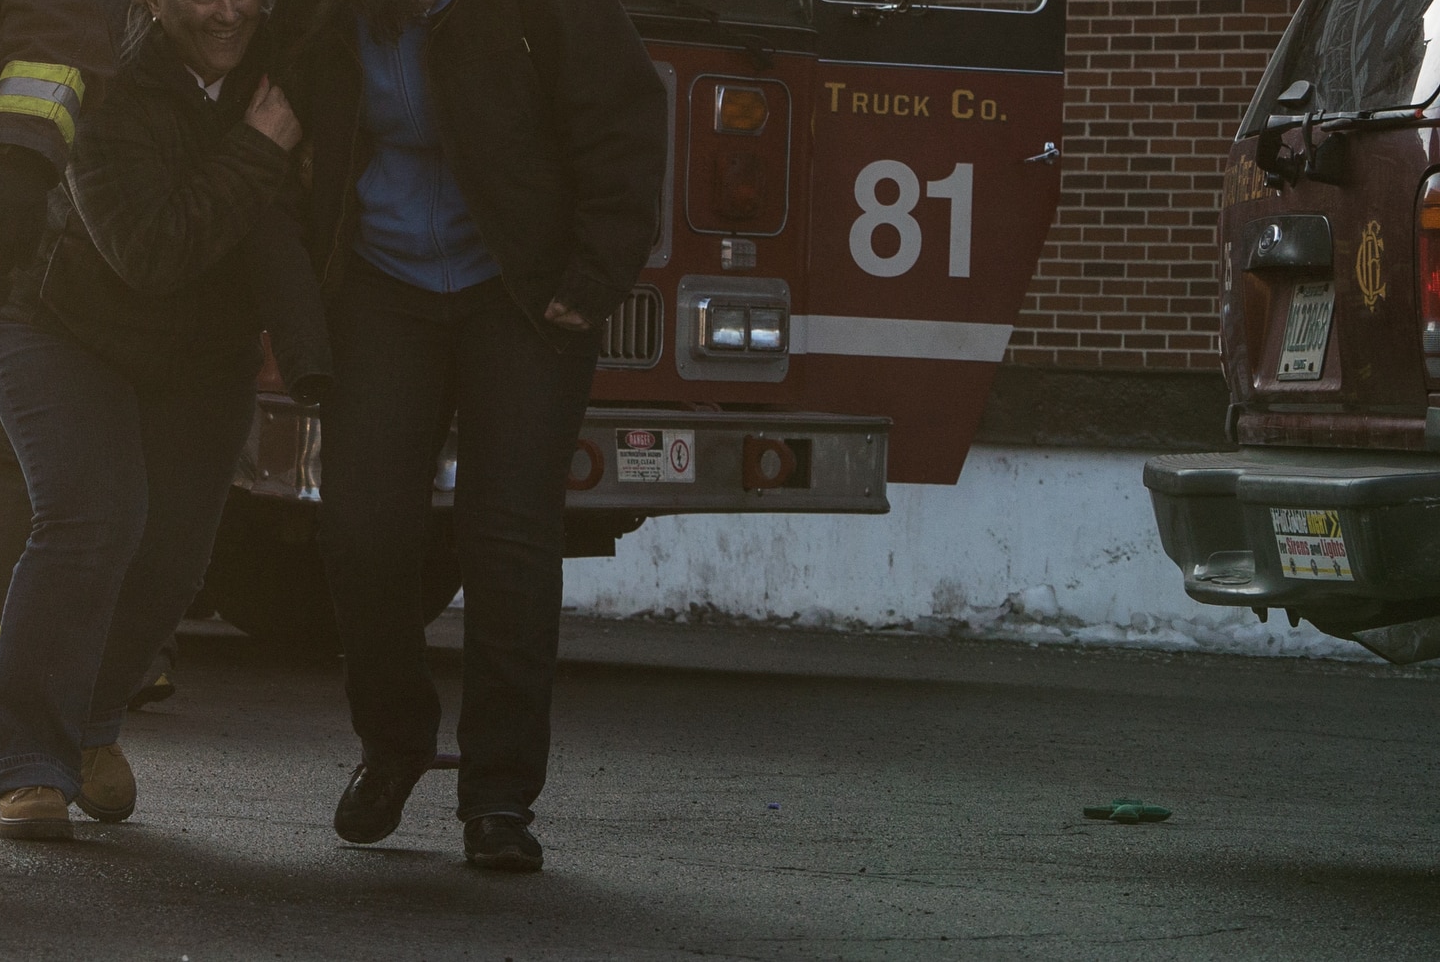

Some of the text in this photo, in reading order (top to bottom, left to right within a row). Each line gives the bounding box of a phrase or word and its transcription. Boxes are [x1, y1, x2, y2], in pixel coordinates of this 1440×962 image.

[824, 81, 1007, 122] TRUCK CO.
[849, 159, 974, 279] 81
[628, 433, 651, 447] DANGER
[1286, 537, 1310, 555] Sirens
[1320, 539, 1346, 559] Lights
